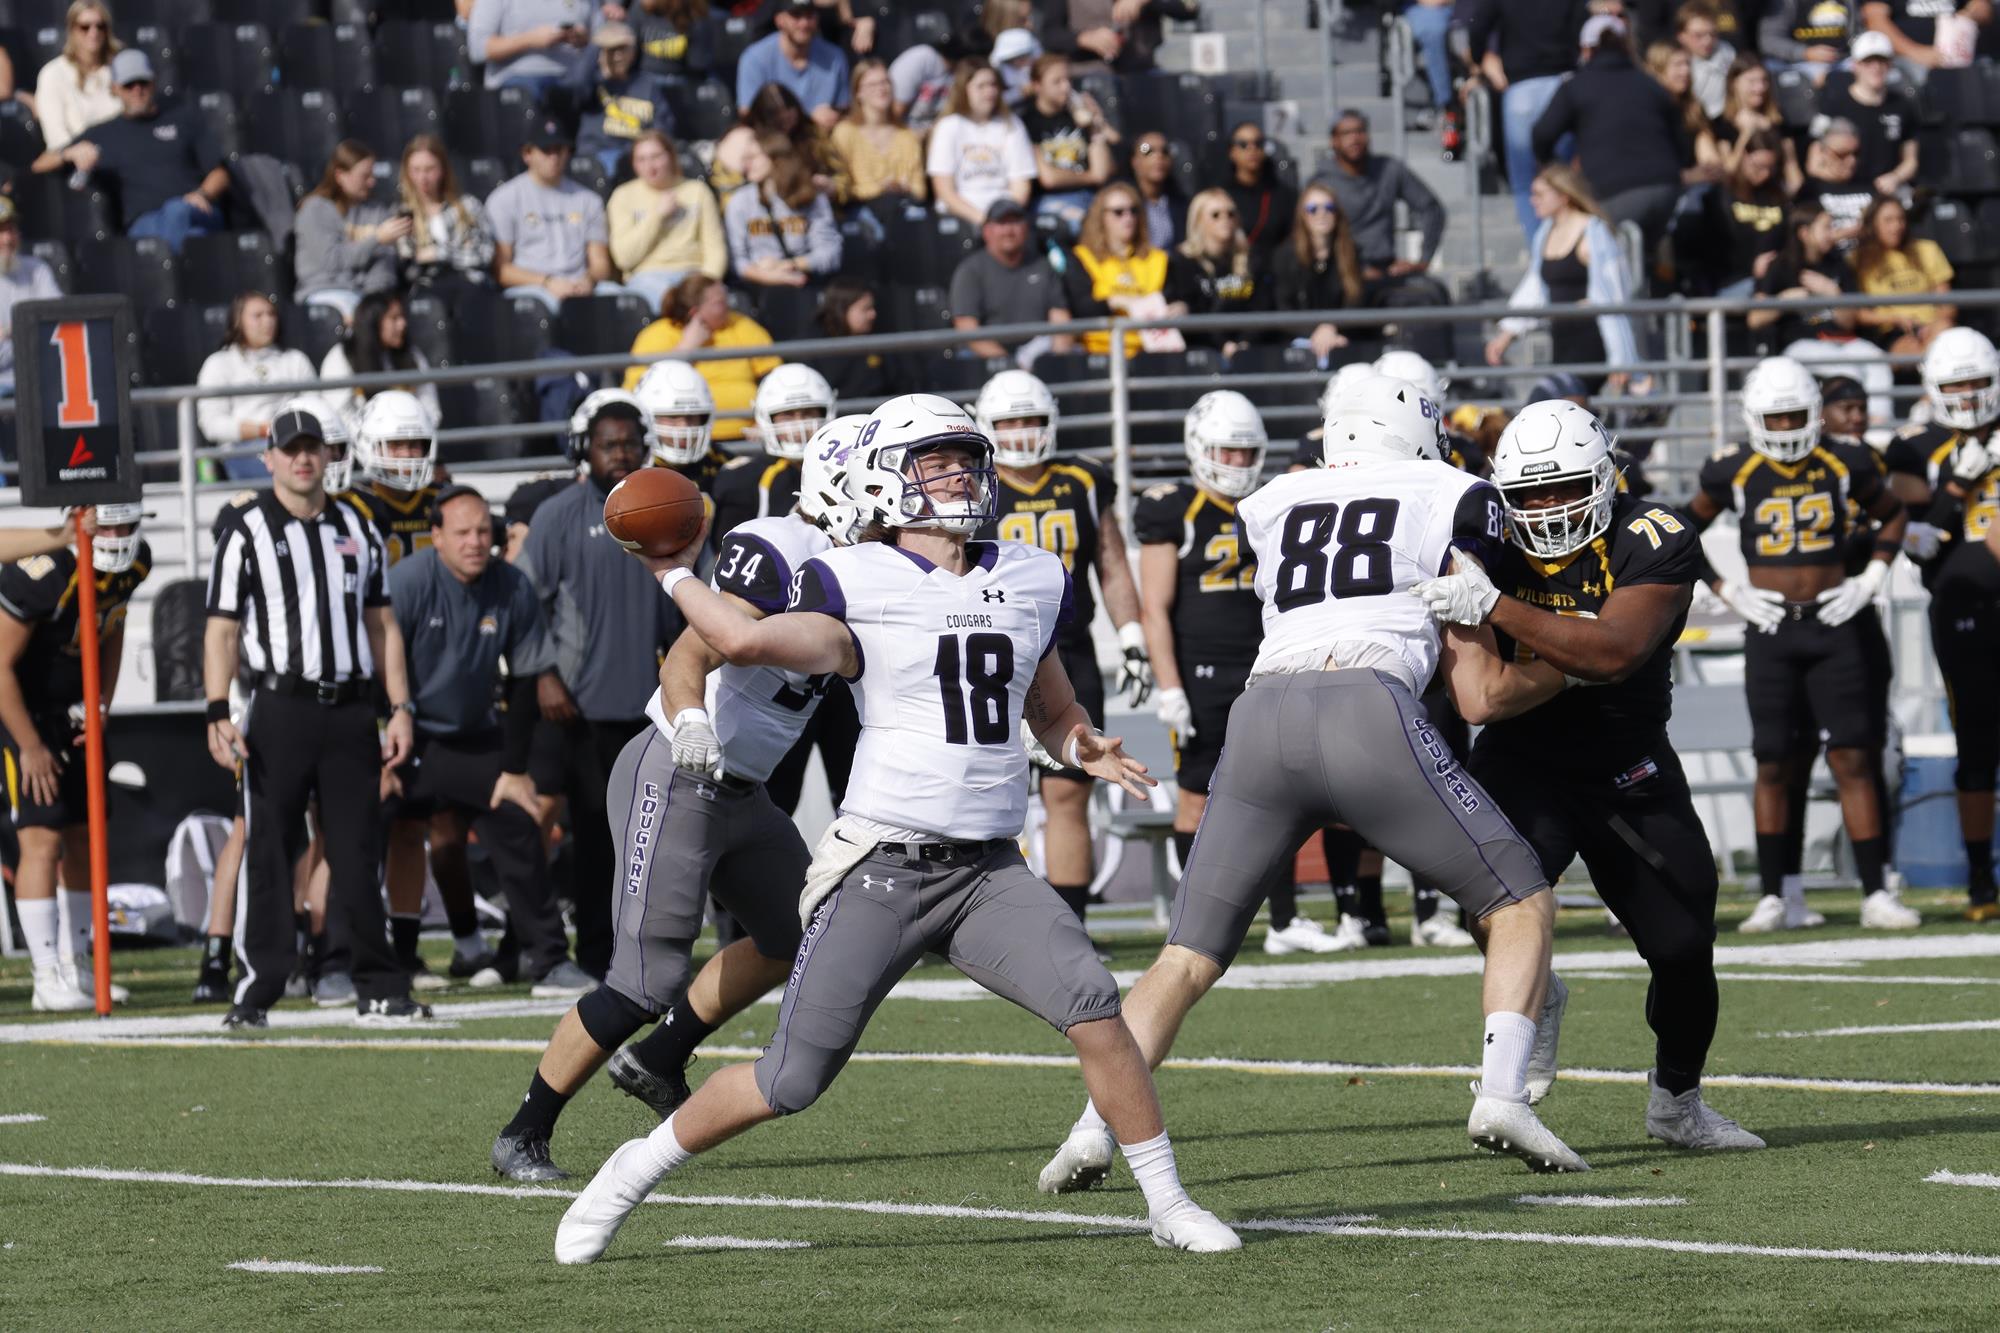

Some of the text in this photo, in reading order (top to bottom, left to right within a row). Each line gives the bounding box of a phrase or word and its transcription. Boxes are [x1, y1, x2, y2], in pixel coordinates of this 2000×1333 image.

[50, 321, 99, 428] 1
[854, 419, 881, 449] 18
[1523, 462, 1555, 474] Riddell
[1627, 508, 1685, 550] 75
[1754, 492, 1835, 556] 32
[720, 544, 763, 587] 34
[1274, 497, 1400, 613] 88
[1516, 585, 1577, 607] WILDCATS
[946, 614, 992, 628] COUGARS
[933, 632, 1014, 744] 18
[627, 781, 658, 895] COUGARS
